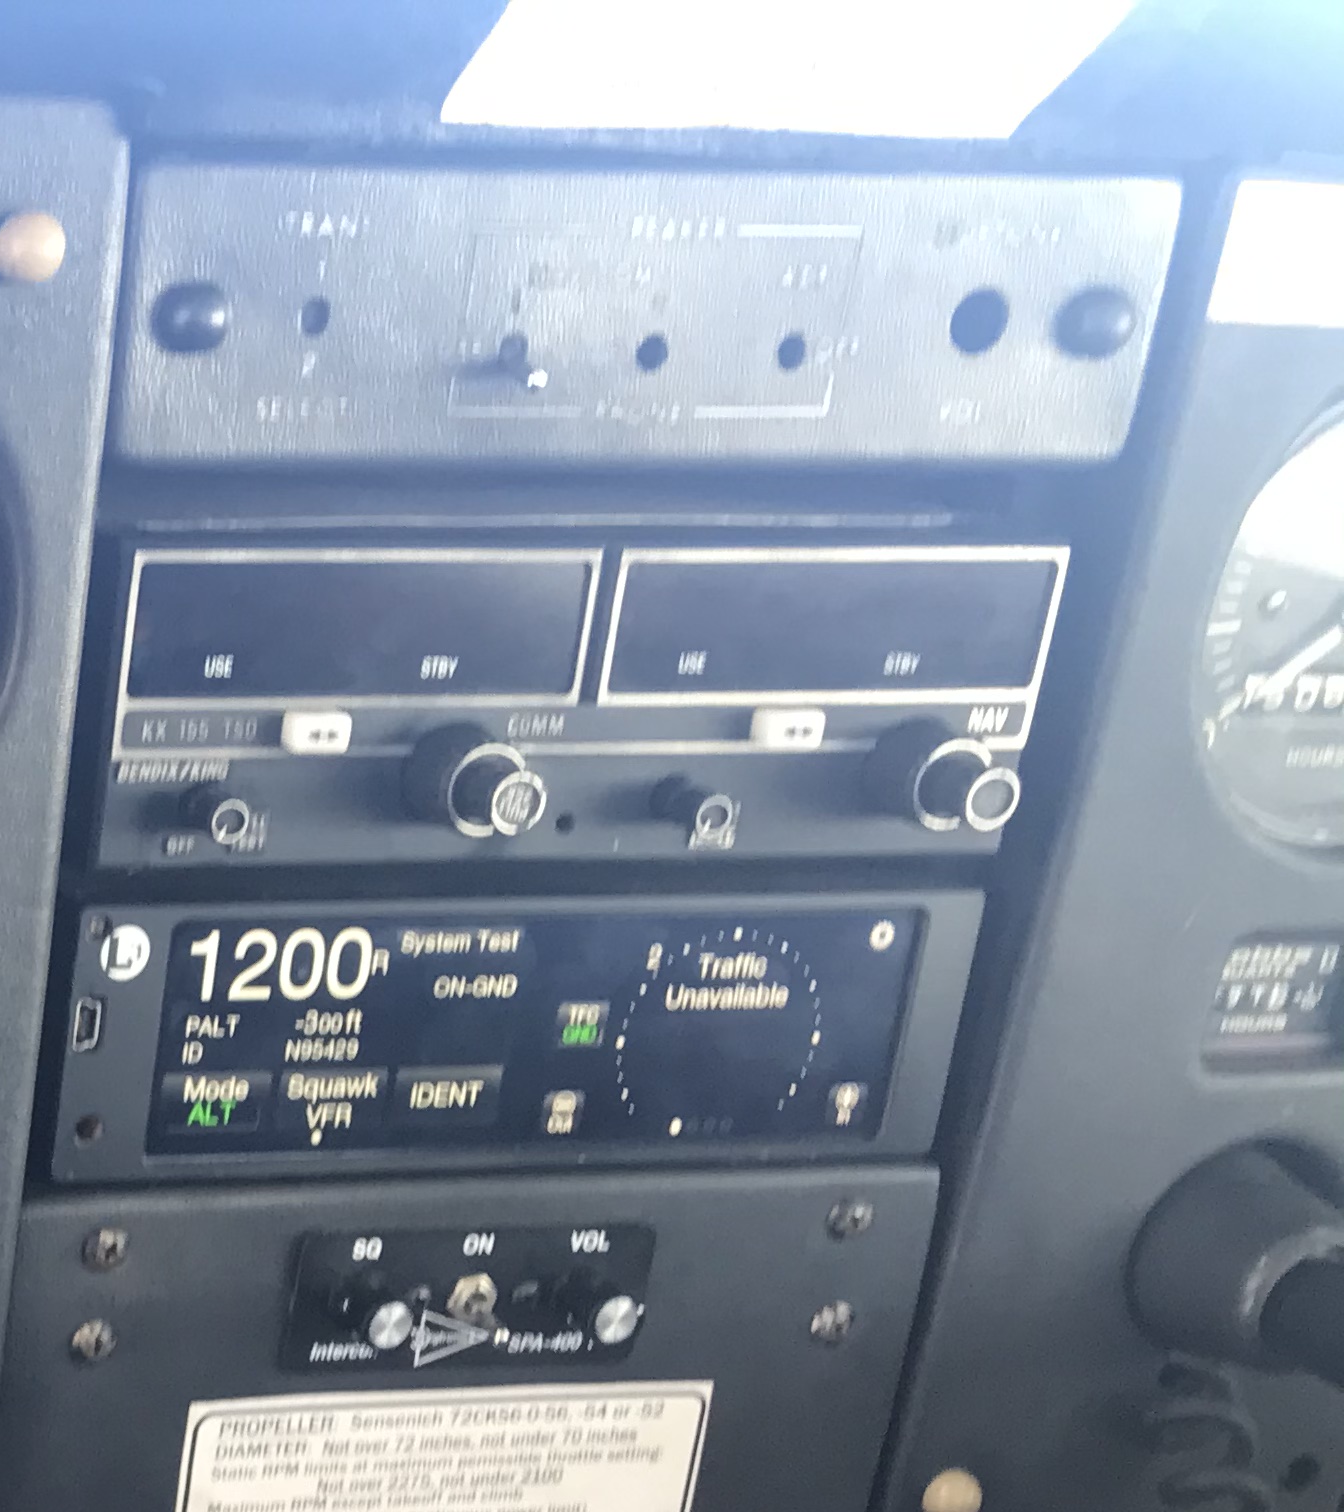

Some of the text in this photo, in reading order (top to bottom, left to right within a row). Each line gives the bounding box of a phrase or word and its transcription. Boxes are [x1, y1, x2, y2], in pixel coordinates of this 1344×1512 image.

[204, 654, 234, 680] USE
[420, 655, 459, 681] STBY
[678, 651, 707, 676] USE
[141, 718, 166, 743] KX
[507, 713, 565, 738] COMM
[968, 706, 1009, 733] NAV
[116, 758, 230, 785] BENDIX/KING
[401, 928, 520, 960] System Test
[190, 926, 373, 1003] 1200
[699, 951, 768, 981] Traffic
[433, 974, 518, 1000] ON-GND
[666, 981, 790, 1012] Unavailable
[185, 1013, 240, 1039] PALT
[182, 1041, 204, 1066] ID
[183, 1074, 249, 1104] Mode
[287, 1071, 380, 1104] Squawk
[410, 1080, 485, 1110] IDENT
[188, 1100, 237, 1127] ALT
[306, 1103, 353, 1130] VFR
[463, 1231, 495, 1256] ON
[571, 1229, 610, 1254] VOL
